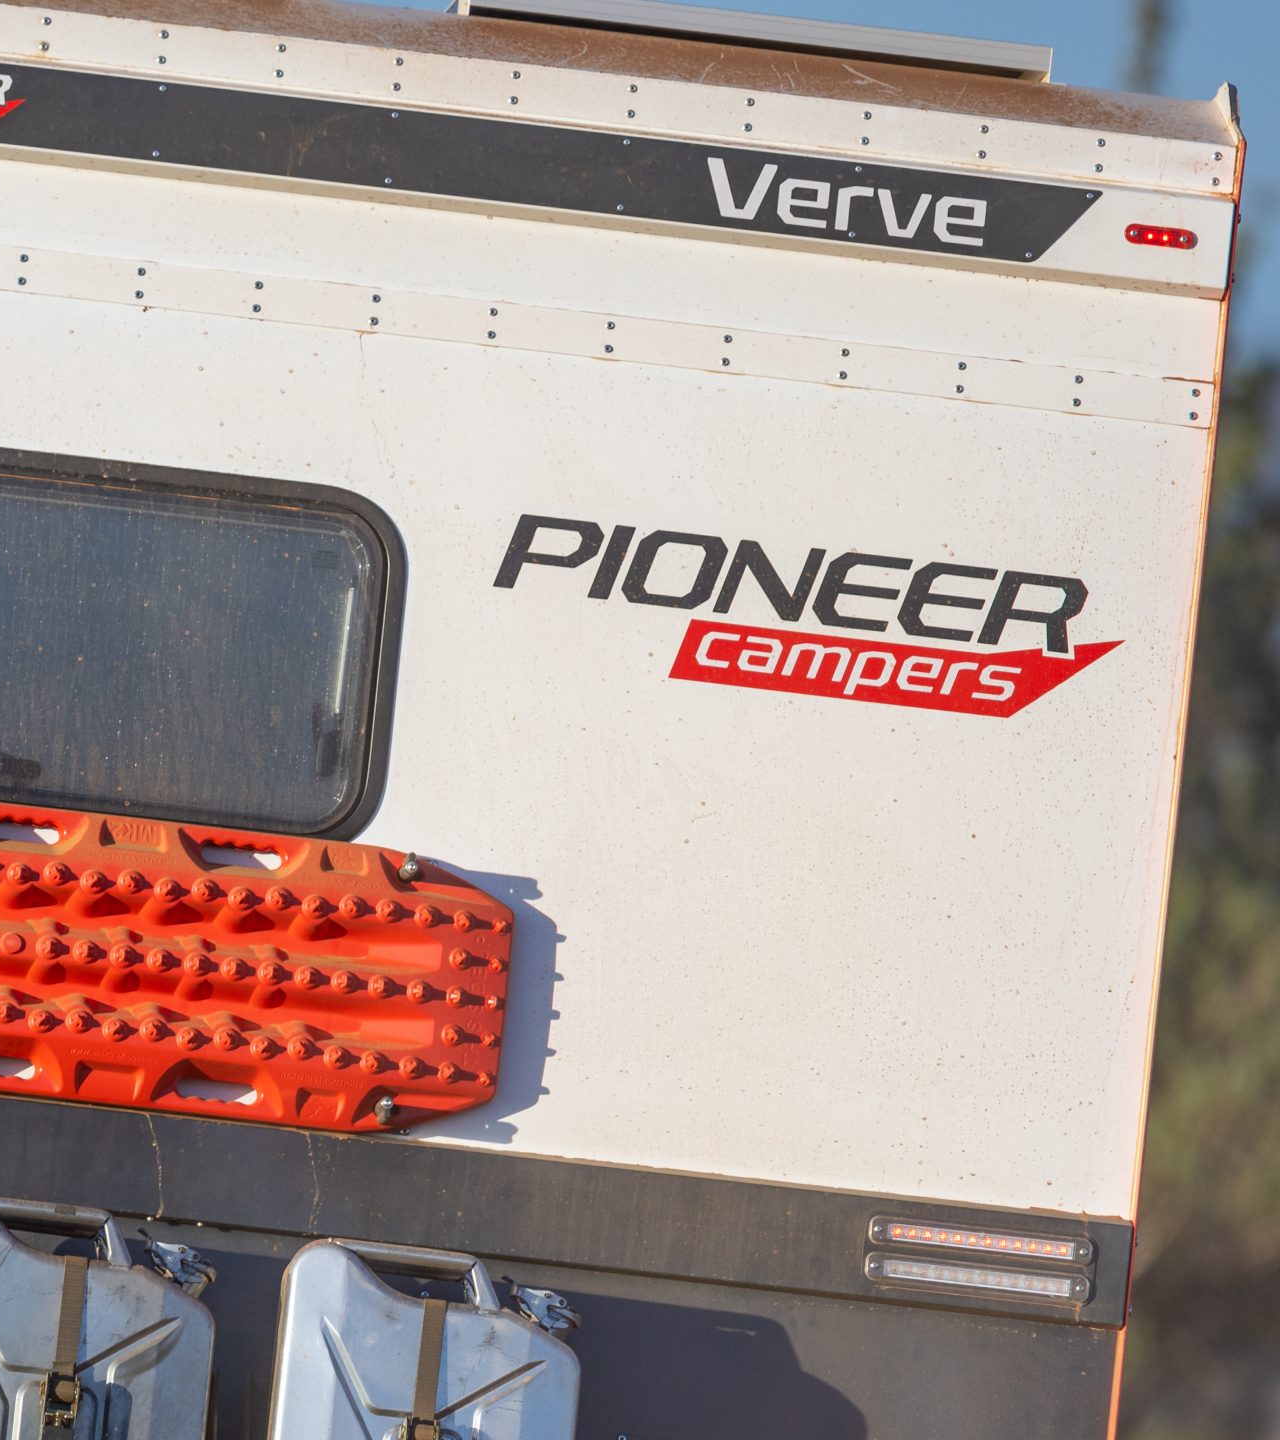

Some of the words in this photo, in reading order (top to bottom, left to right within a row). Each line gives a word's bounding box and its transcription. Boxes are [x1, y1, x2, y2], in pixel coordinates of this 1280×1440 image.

[707, 157, 987, 247] Verve
[493, 513, 1089, 654] PIONEER
[694, 630, 1023, 702] campers
